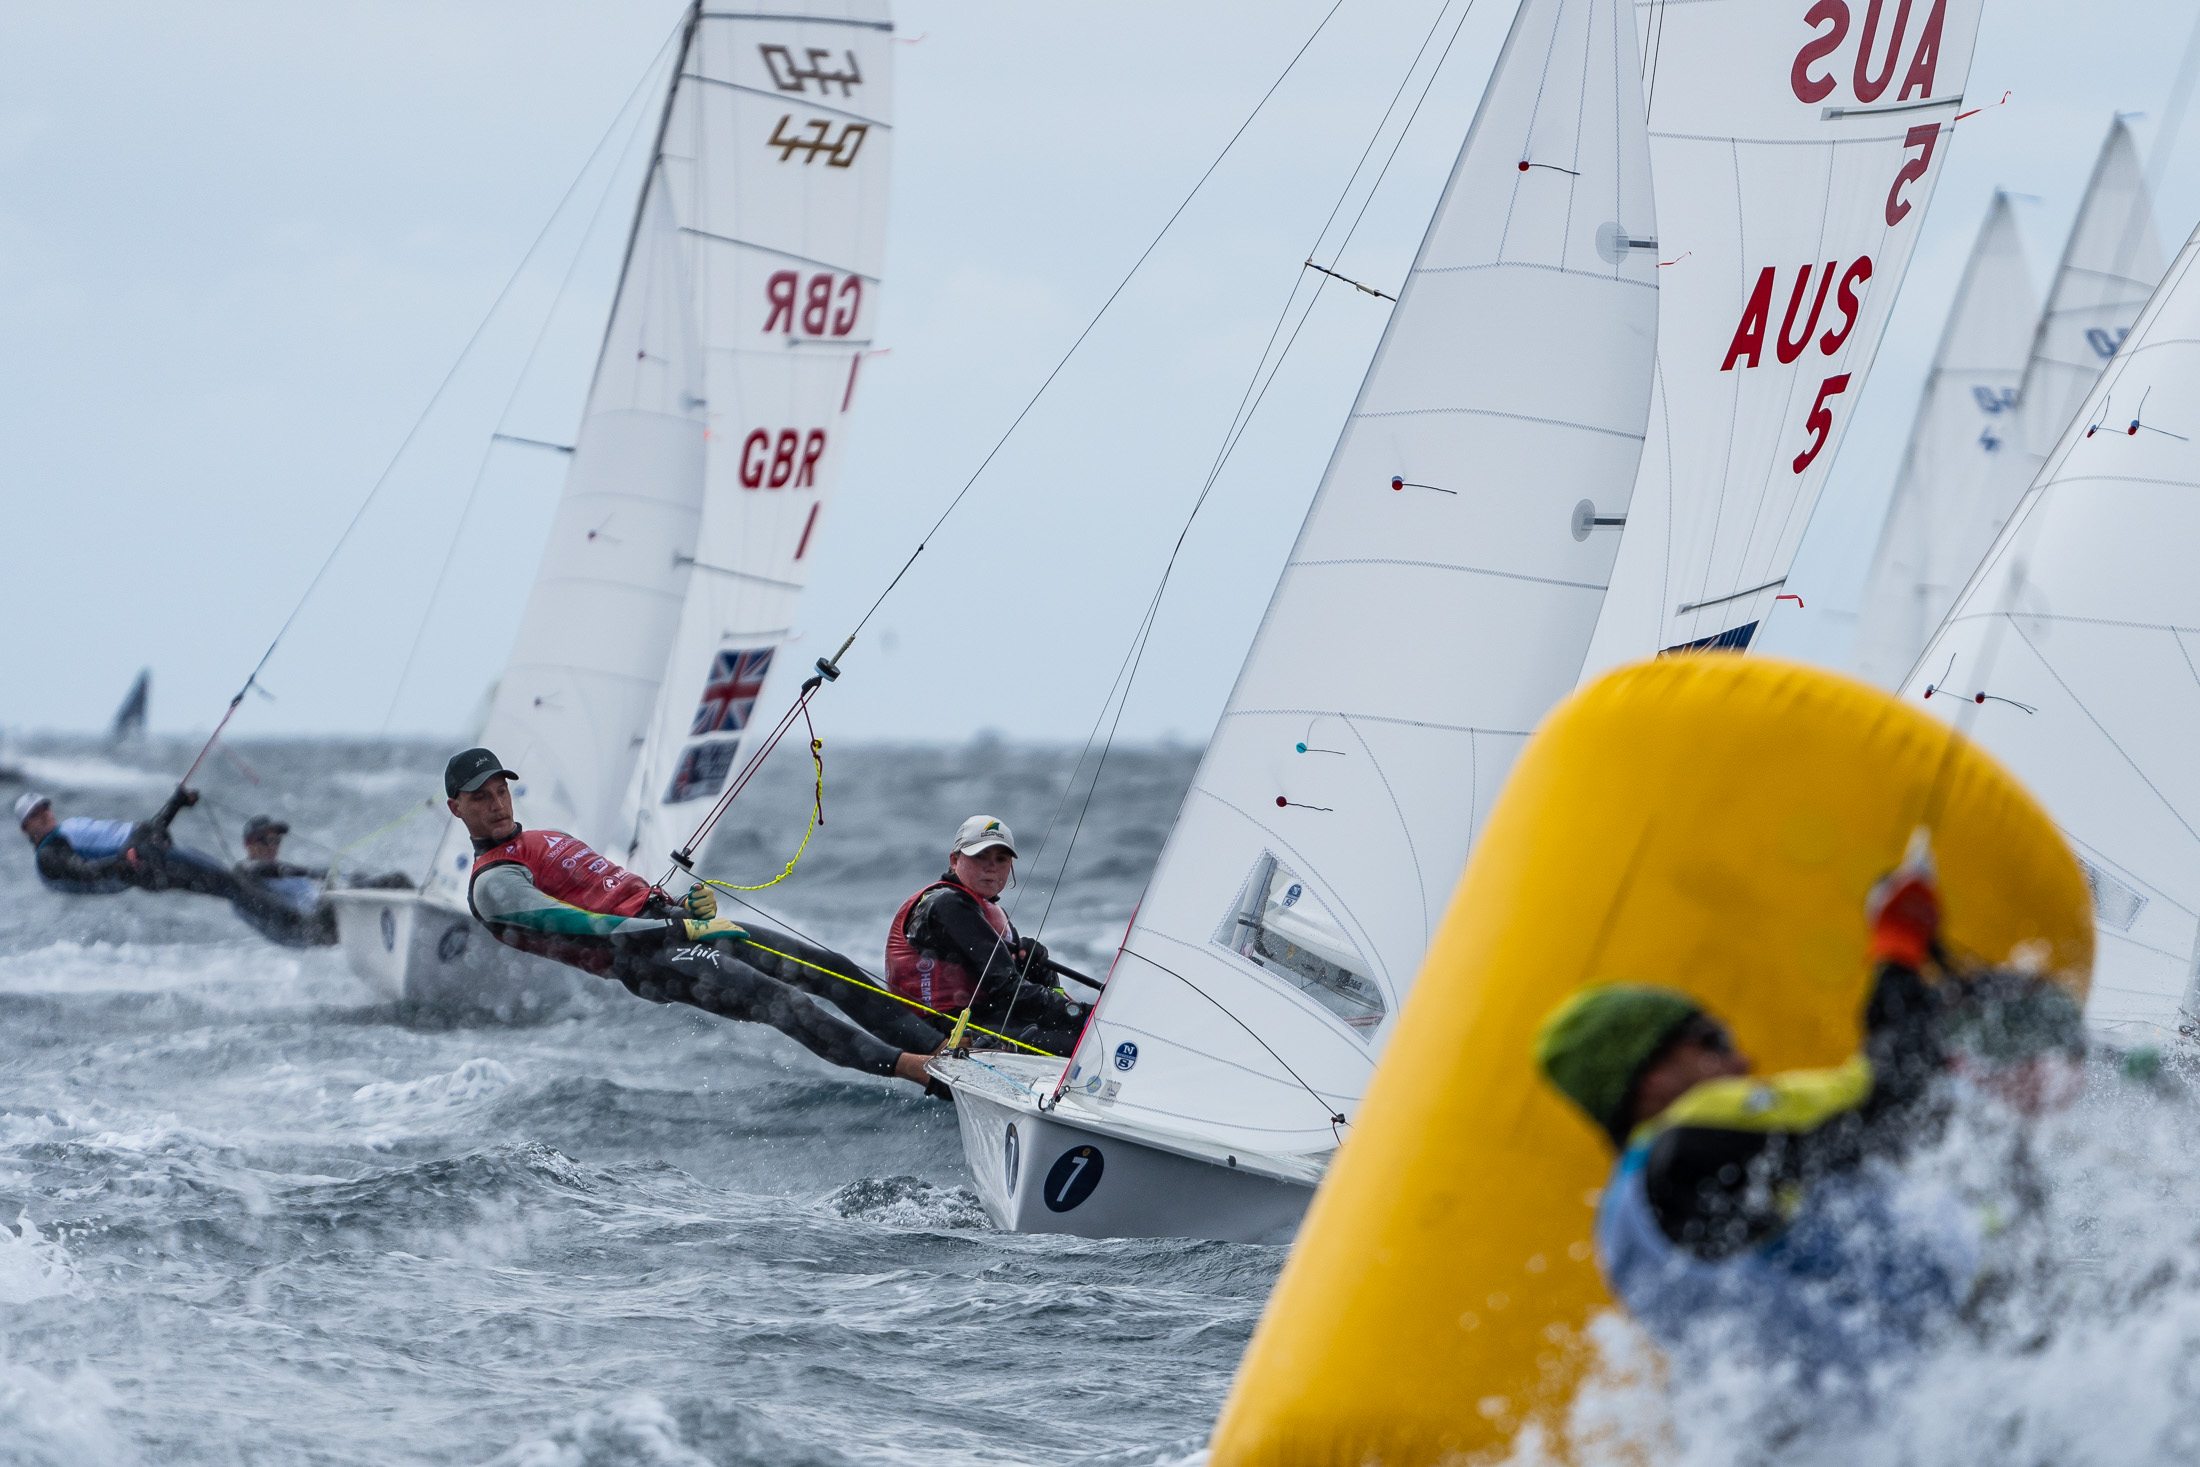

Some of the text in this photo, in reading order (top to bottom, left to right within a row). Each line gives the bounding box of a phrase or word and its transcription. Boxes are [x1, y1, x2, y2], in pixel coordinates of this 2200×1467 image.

[767, 114, 869, 168] 470
[1720, 256, 1872, 371] AUS
[1793, 372, 1851, 474] 5
[739, 427, 826, 489] GBR
[795, 500, 820, 560] 1
[1118, 1058, 1130, 1068] S
[1122, 1044, 1135, 1055] N
